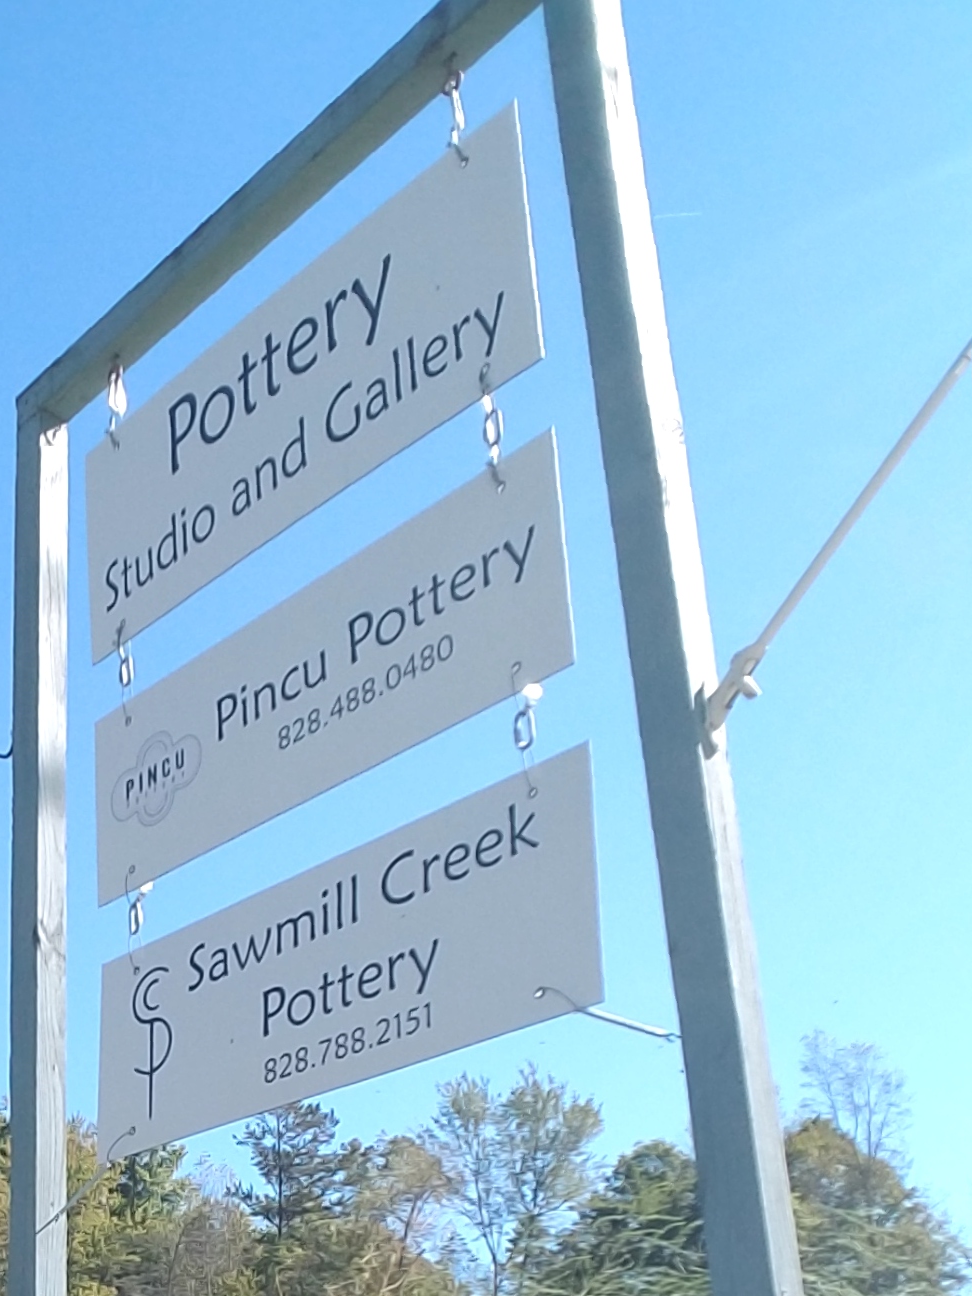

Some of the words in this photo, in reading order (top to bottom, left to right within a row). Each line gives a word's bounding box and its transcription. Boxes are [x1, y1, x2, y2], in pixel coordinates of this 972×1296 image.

[167, 252, 392, 476] Pottery
[105, 503, 216, 614] Studio
[231, 416, 308, 516] and
[324, 290, 505, 444] Gallery
[216, 648, 328, 741] Pincu
[347, 523, 536, 665] Pottery
[277, 633, 454, 750] 828.488.0480
[125, 747, 185, 803] PINCU
[187, 873, 359, 992] Sawmill
[380, 802, 540, 905] Creek
[262, 937, 440, 1037] Pottery
[263, 1001, 433, 1084] 828.788.2151
